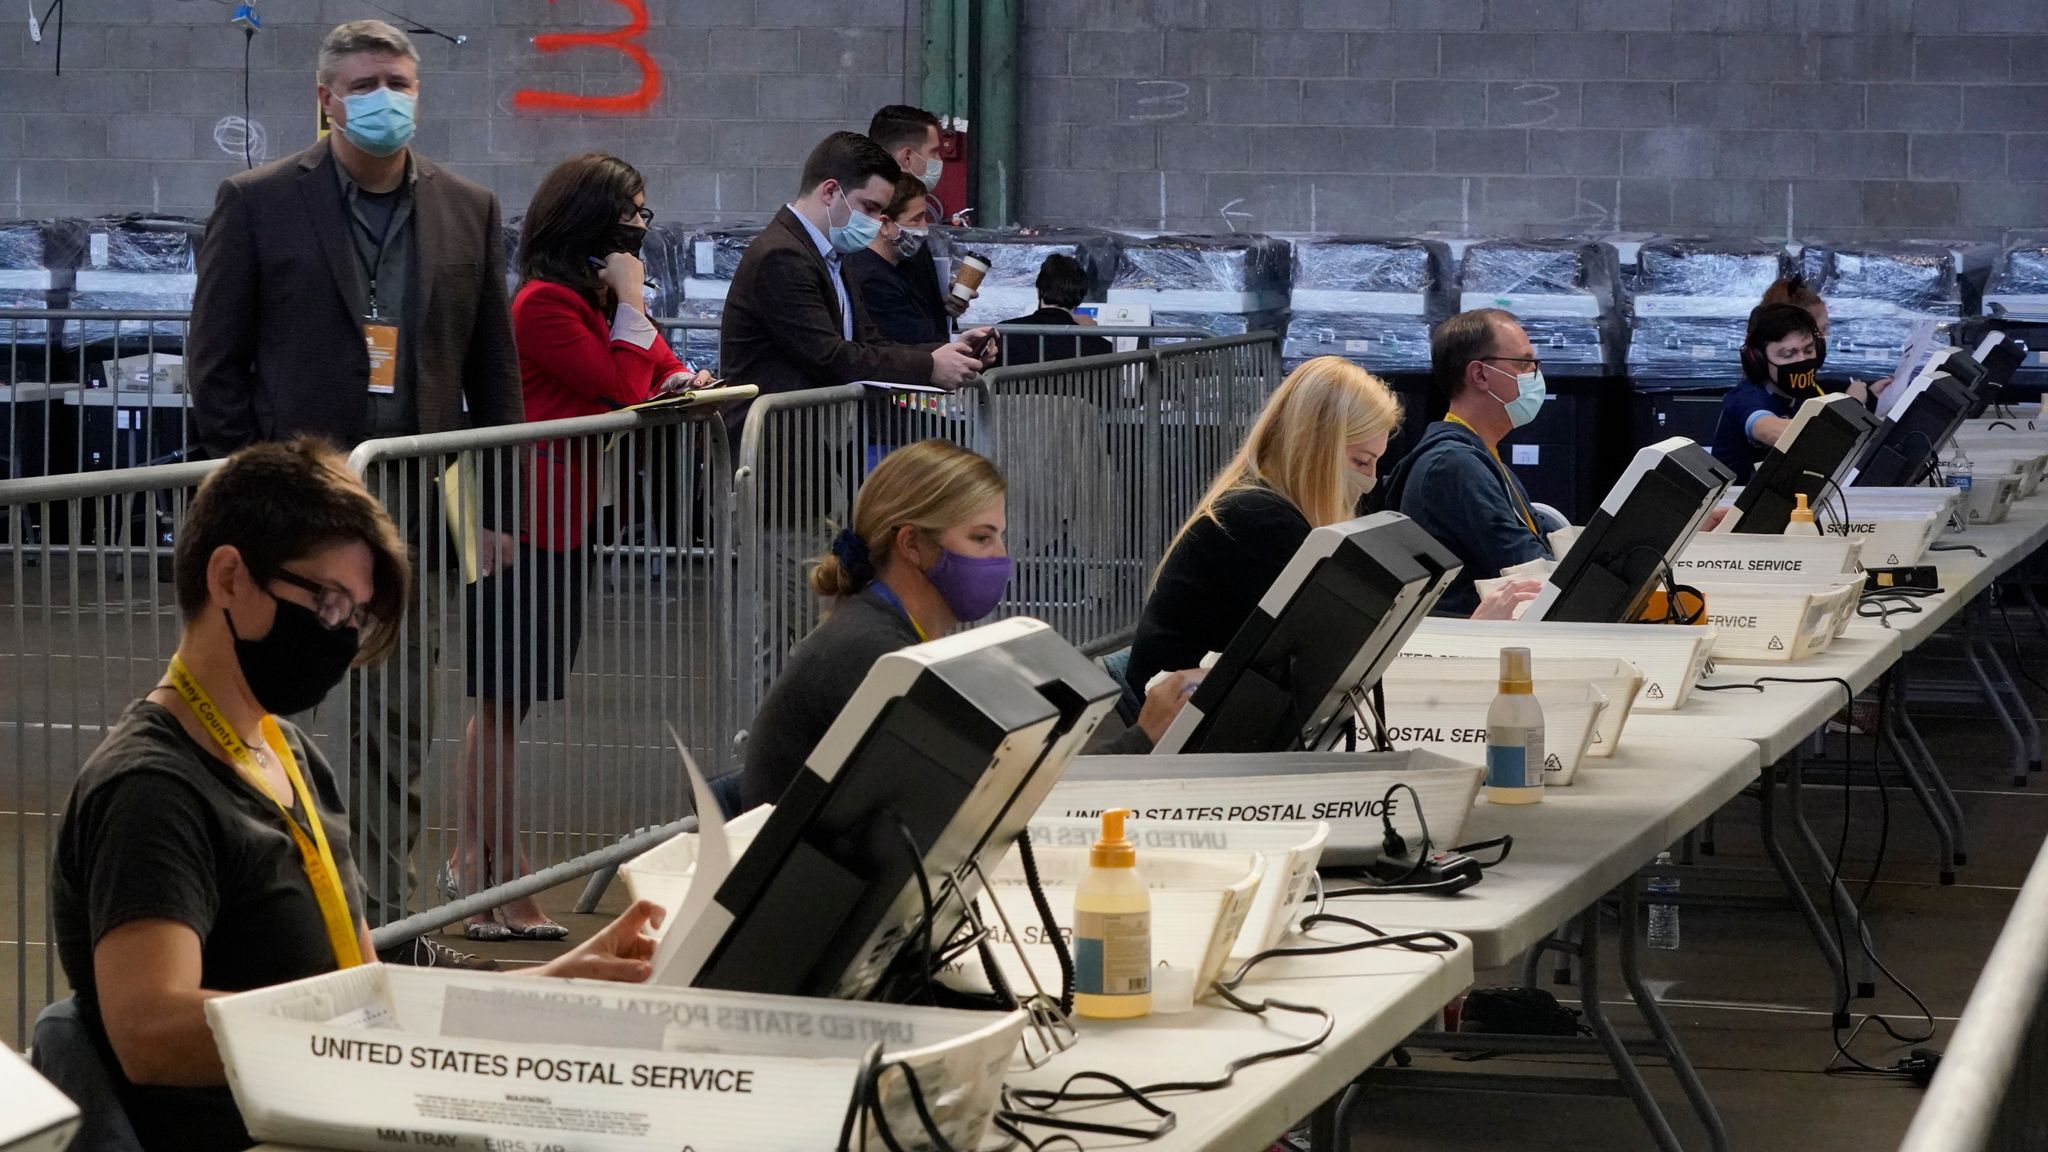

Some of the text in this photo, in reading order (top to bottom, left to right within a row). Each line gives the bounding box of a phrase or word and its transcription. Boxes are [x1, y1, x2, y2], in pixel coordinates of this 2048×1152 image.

[1790, 368, 1816, 388] VOTE
[1697, 560, 1744, 570] POSTAL
[1748, 560, 1802, 571] SERVICE
[1706, 615, 1757, 628] ERVICE
[199, 702, 234, 747] County
[1387, 727, 1445, 742] OSTAL
[1228, 803, 1306, 821] POSTAL
[1312, 800, 1399, 818] SERVICE
[310, 1034, 755, 1094] UNITED STATES POSTAL SERVICE
[376, 1127, 408, 1144] MM
[411, 1131, 458, 1149] TRAY
